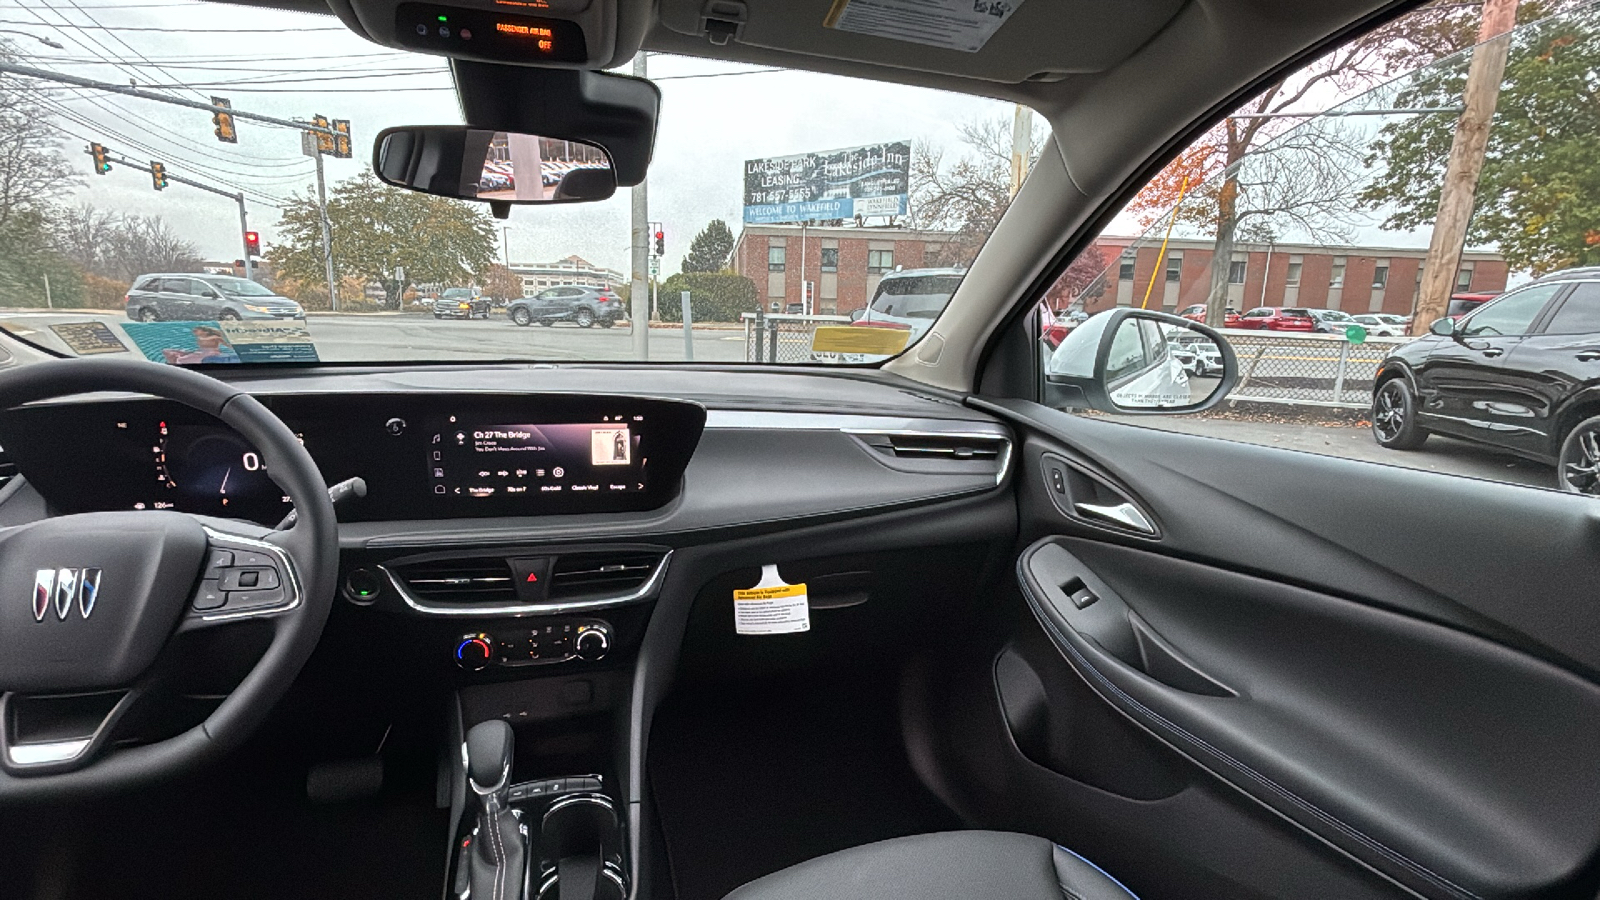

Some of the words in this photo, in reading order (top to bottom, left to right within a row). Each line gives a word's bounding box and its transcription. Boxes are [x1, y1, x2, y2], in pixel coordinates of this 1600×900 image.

[539, 40, 552, 49] OFF
[882, 146, 902, 165] Inn
[748, 161, 789, 174] LAKESIDE
[791, 156, 816, 170] PARK
[761, 174, 799, 187] LEASING
[749, 205, 783, 216] WELCOME
[786, 204, 796, 213] TO
[800, 203, 841, 213] WAKEFIELD
[484, 431, 493, 439] 27
[508, 432, 531, 440] Bridge
[243, 453, 259, 471] 0
